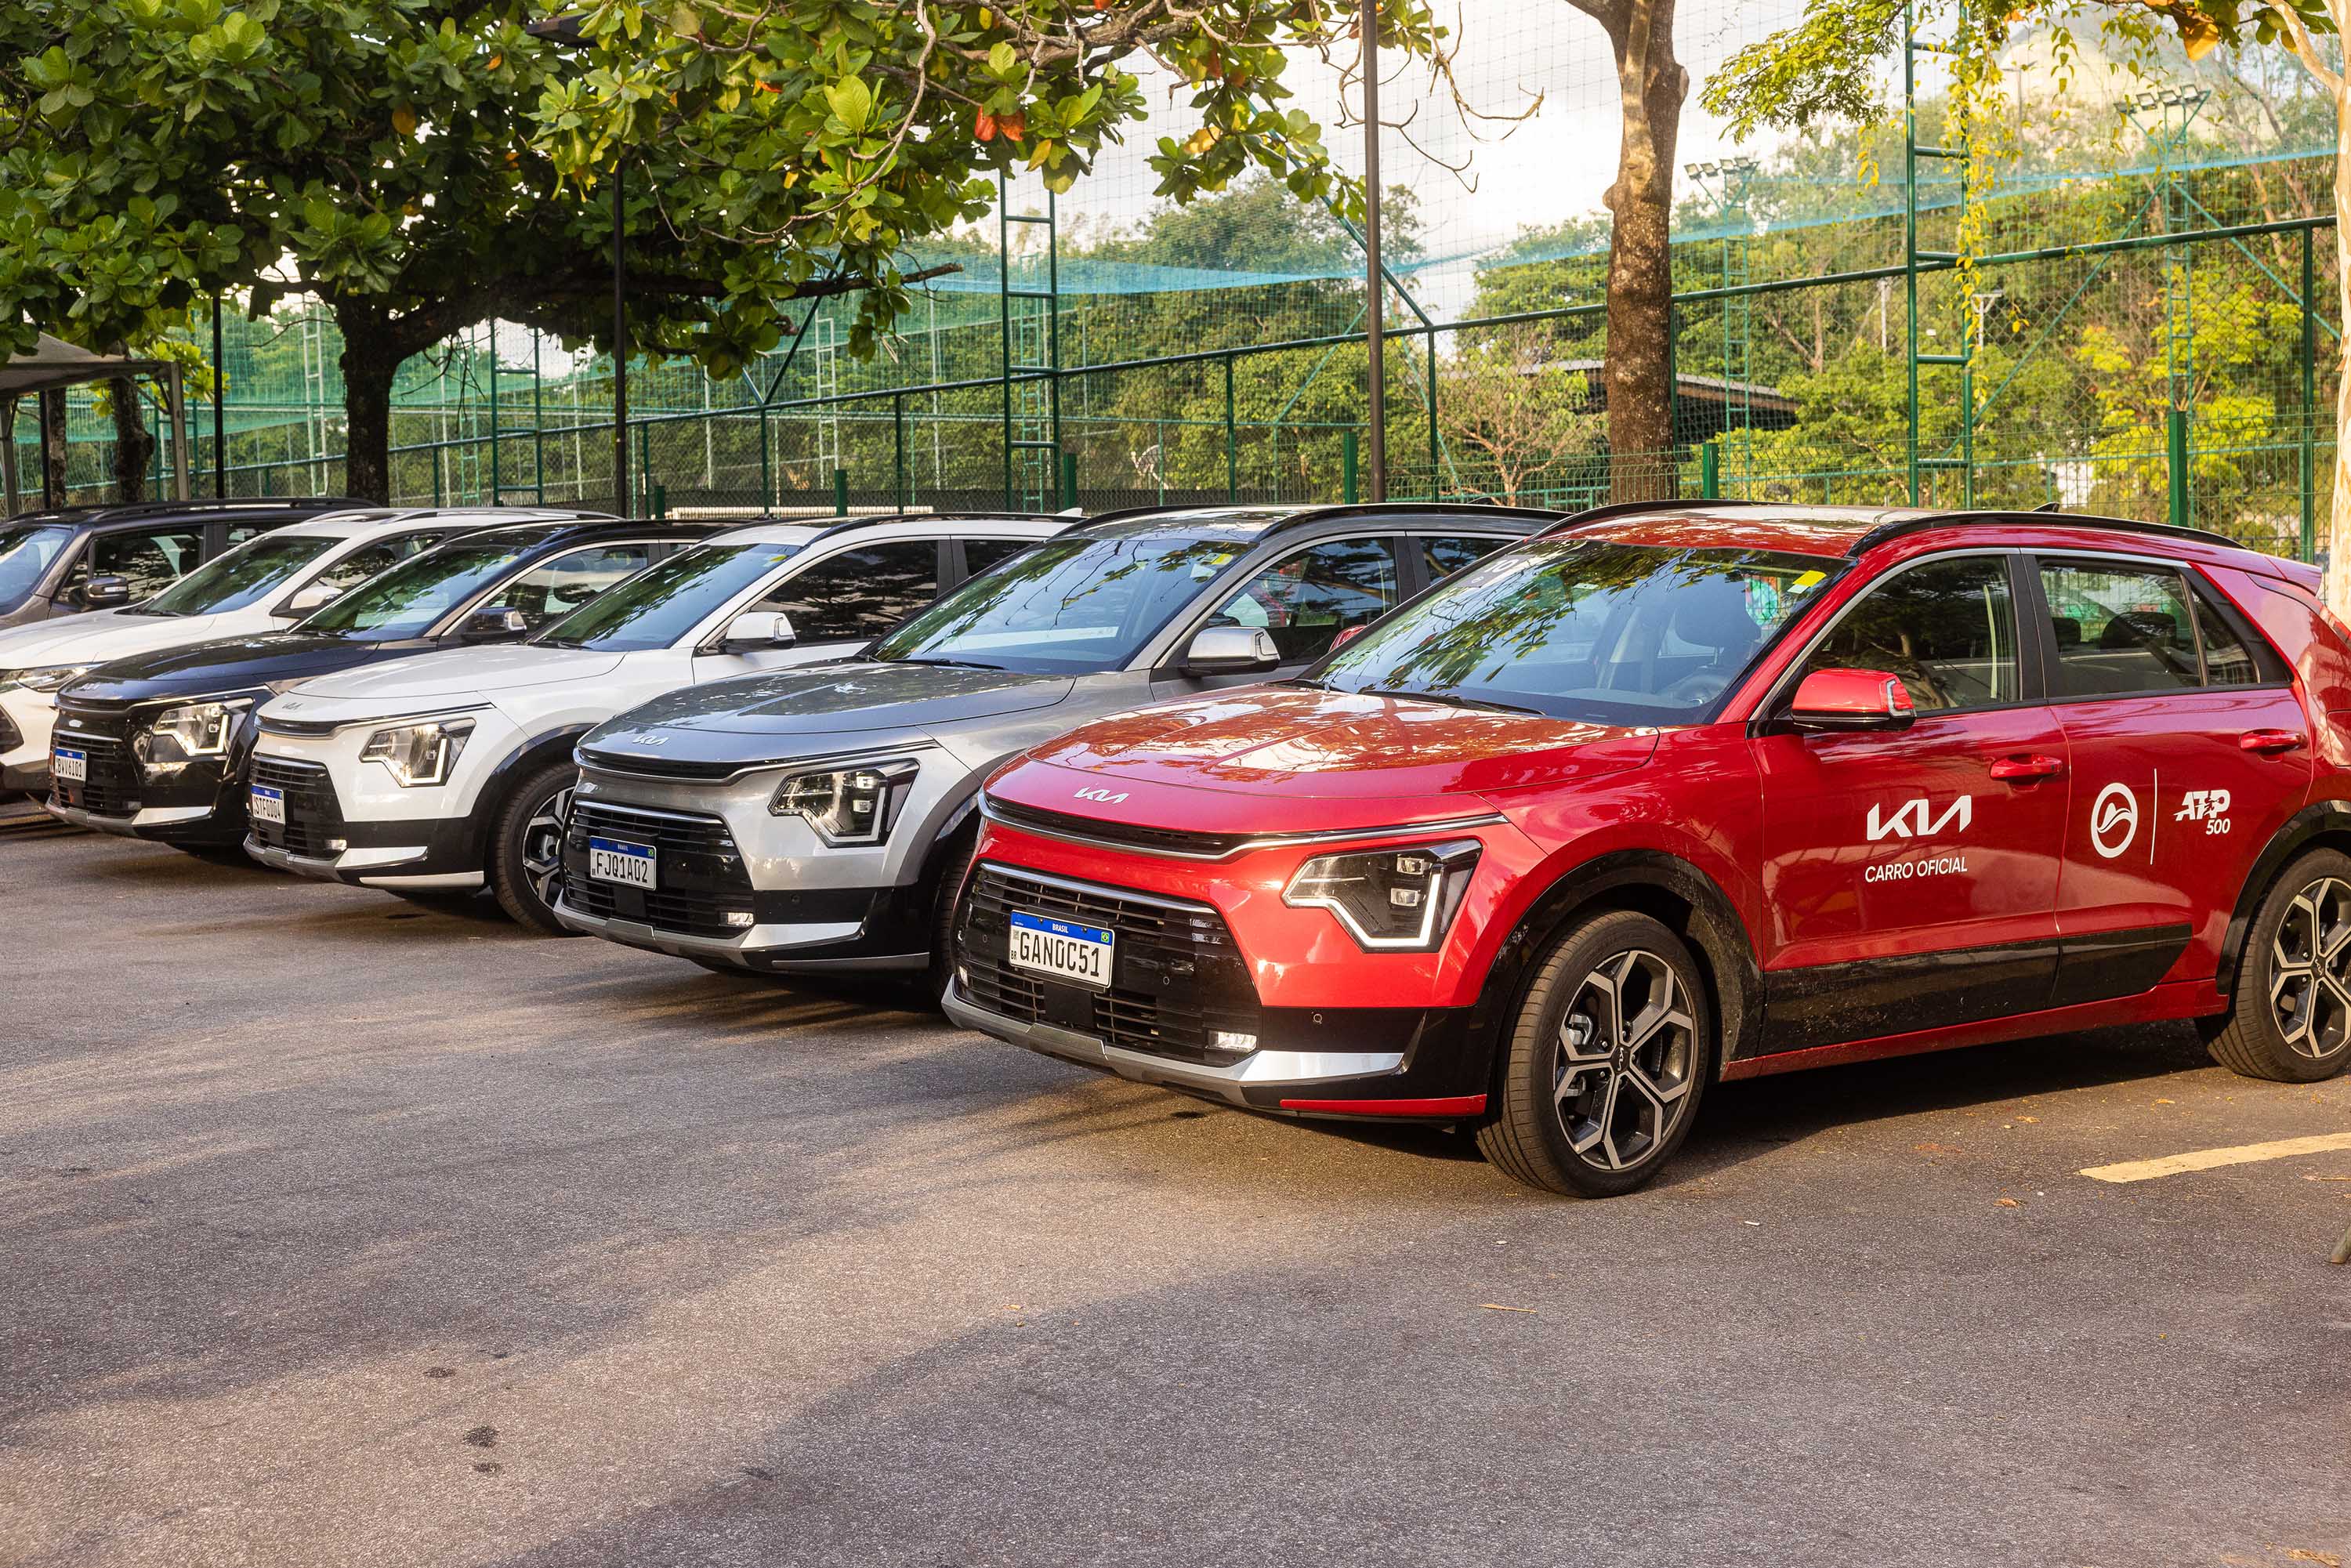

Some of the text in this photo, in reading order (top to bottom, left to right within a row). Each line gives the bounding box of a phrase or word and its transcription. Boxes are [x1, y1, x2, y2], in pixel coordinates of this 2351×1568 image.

[1074, 786, 1129, 804] KIA
[2173, 789, 2230, 821] ATP
[1867, 795, 1972, 841] KIA
[2205, 818, 2231, 835] 500
[596, 852, 648, 884] FJQ1A02
[1864, 856, 1968, 883] CARRO OFICIAL
[1052, 923, 1069, 934] BRASIL
[1020, 931, 1099, 977] GAN0C51
